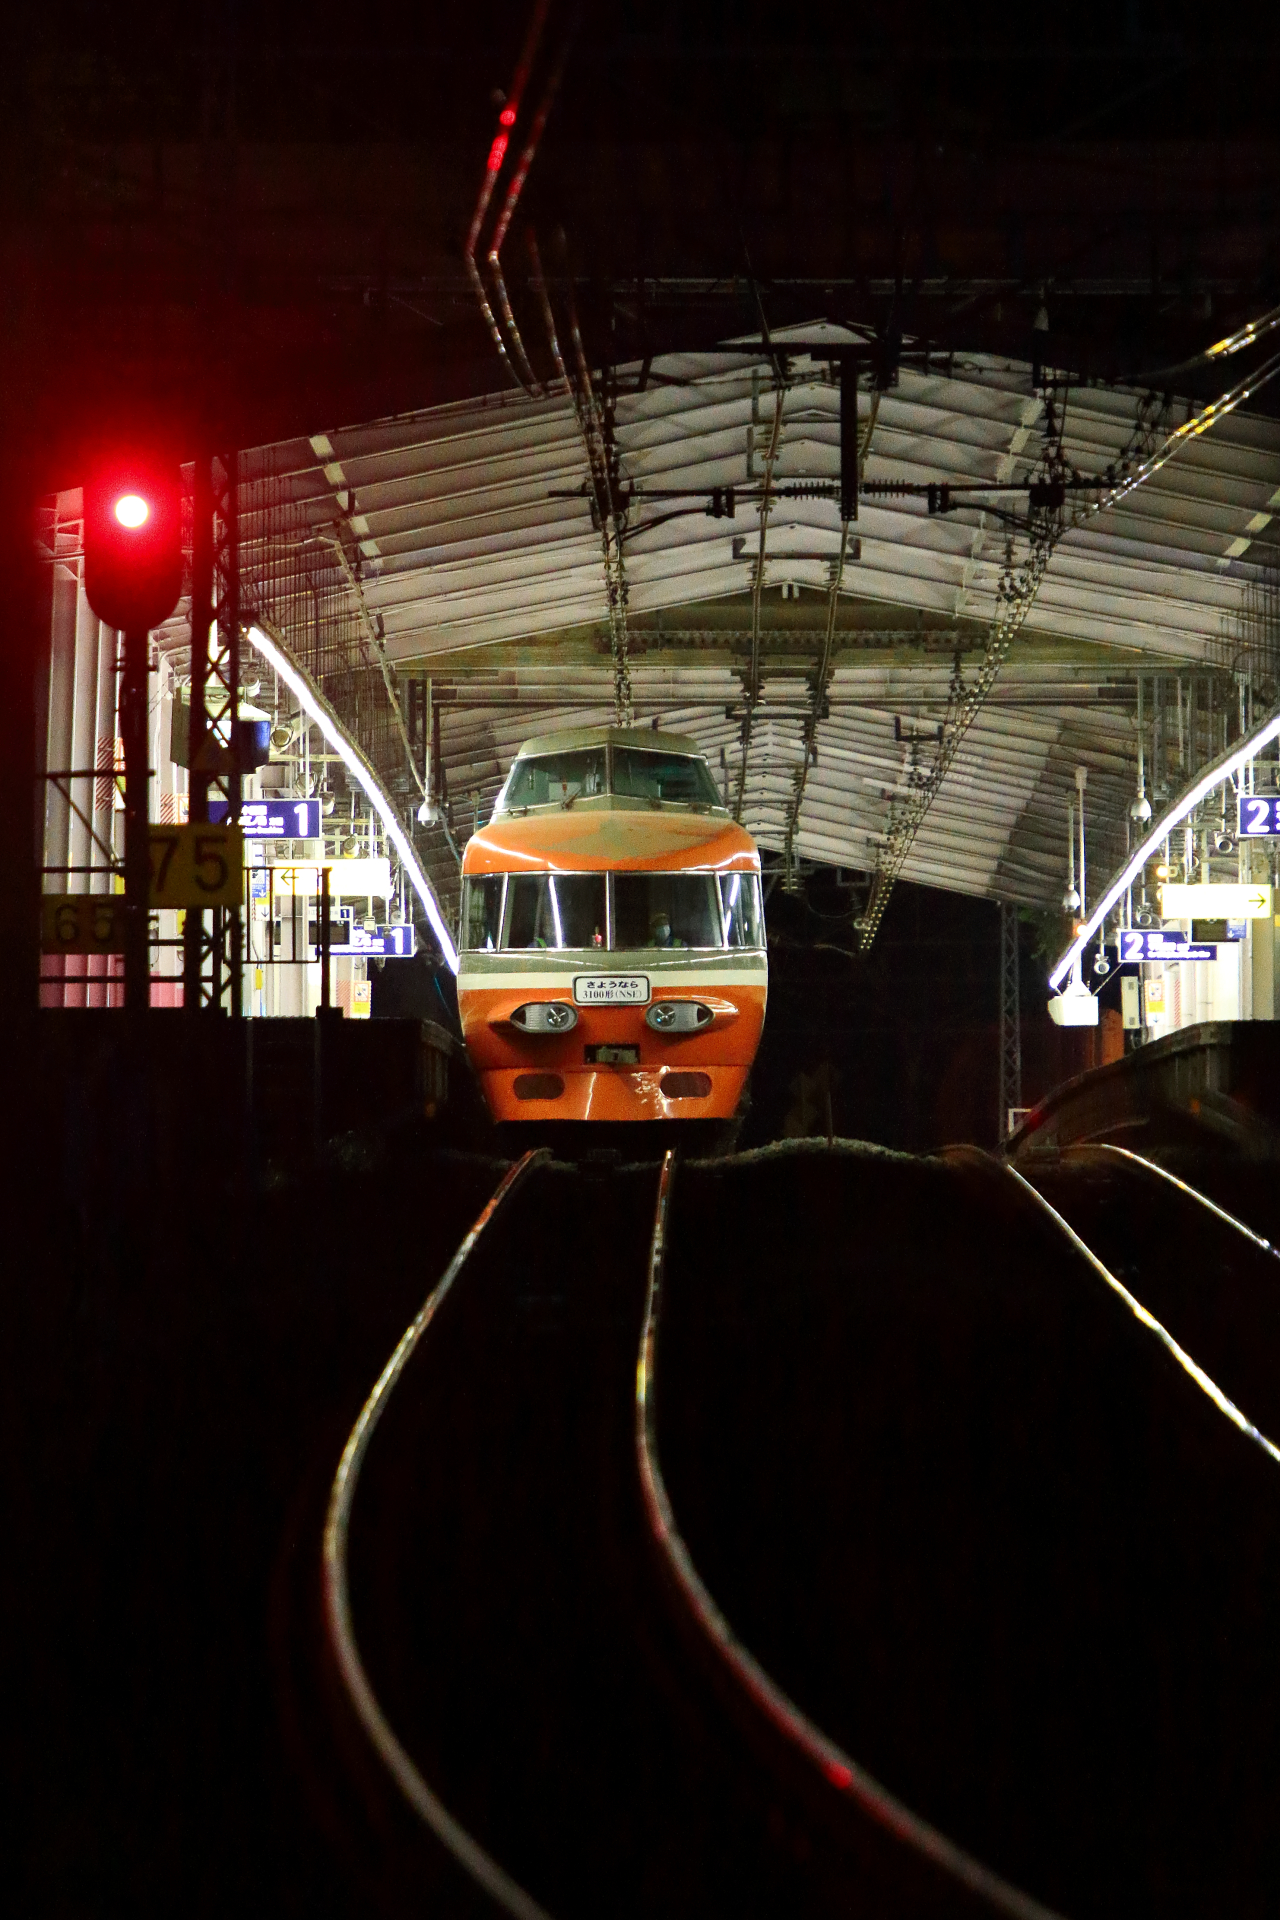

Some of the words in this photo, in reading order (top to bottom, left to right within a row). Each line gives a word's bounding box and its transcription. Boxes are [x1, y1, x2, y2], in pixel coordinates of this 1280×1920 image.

[293, 803, 308, 837] 1
[1247, 799, 1270, 833] 2
[149, 836, 228, 891] 75
[390, 928, 403, 954] 1
[1125, 933, 1144, 959] 2
[587, 981, 639, 989] さようなら
